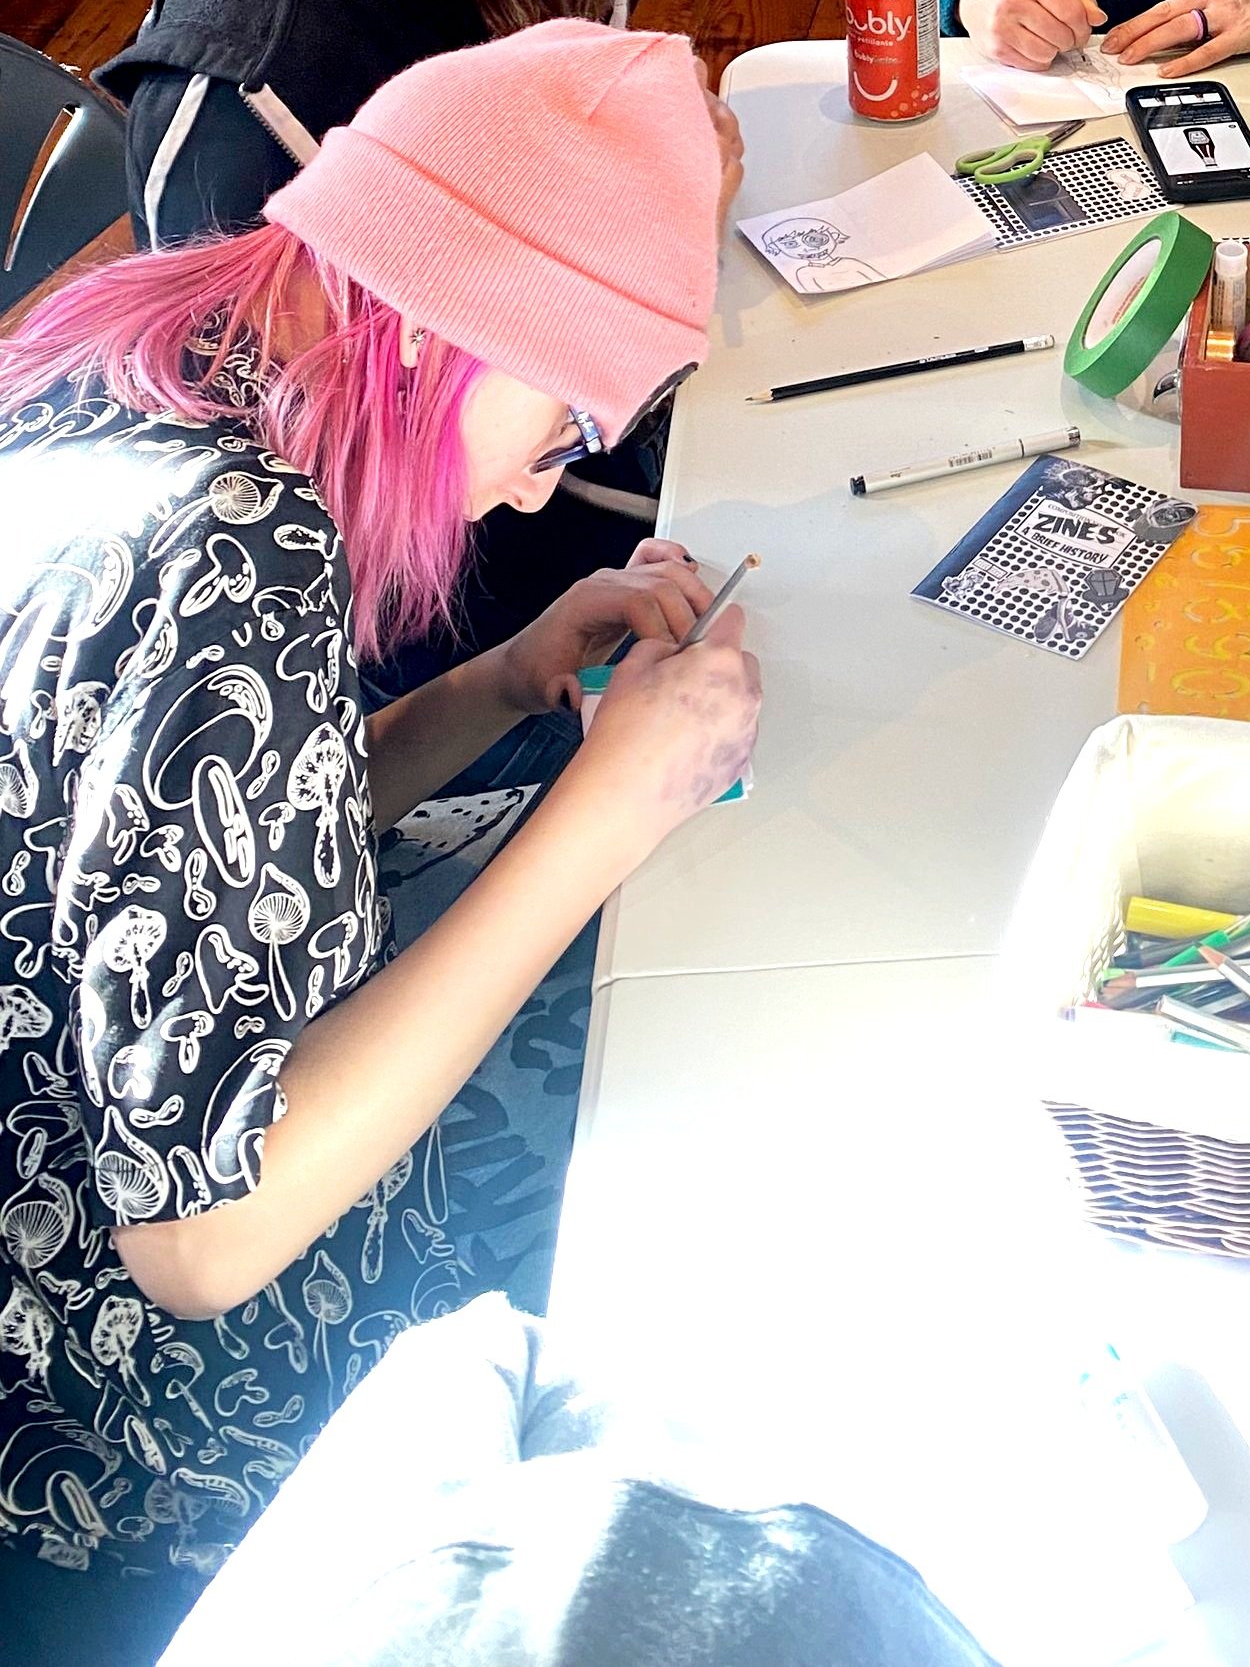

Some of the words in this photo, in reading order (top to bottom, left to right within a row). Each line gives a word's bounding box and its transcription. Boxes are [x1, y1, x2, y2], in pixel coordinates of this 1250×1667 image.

[1021, 527, 1031, 536] A
[1032, 532, 1061, 551] BRIEF
[1060, 544, 1109, 564] HISTORY
[1032, 513, 1119, 545] ZINES
